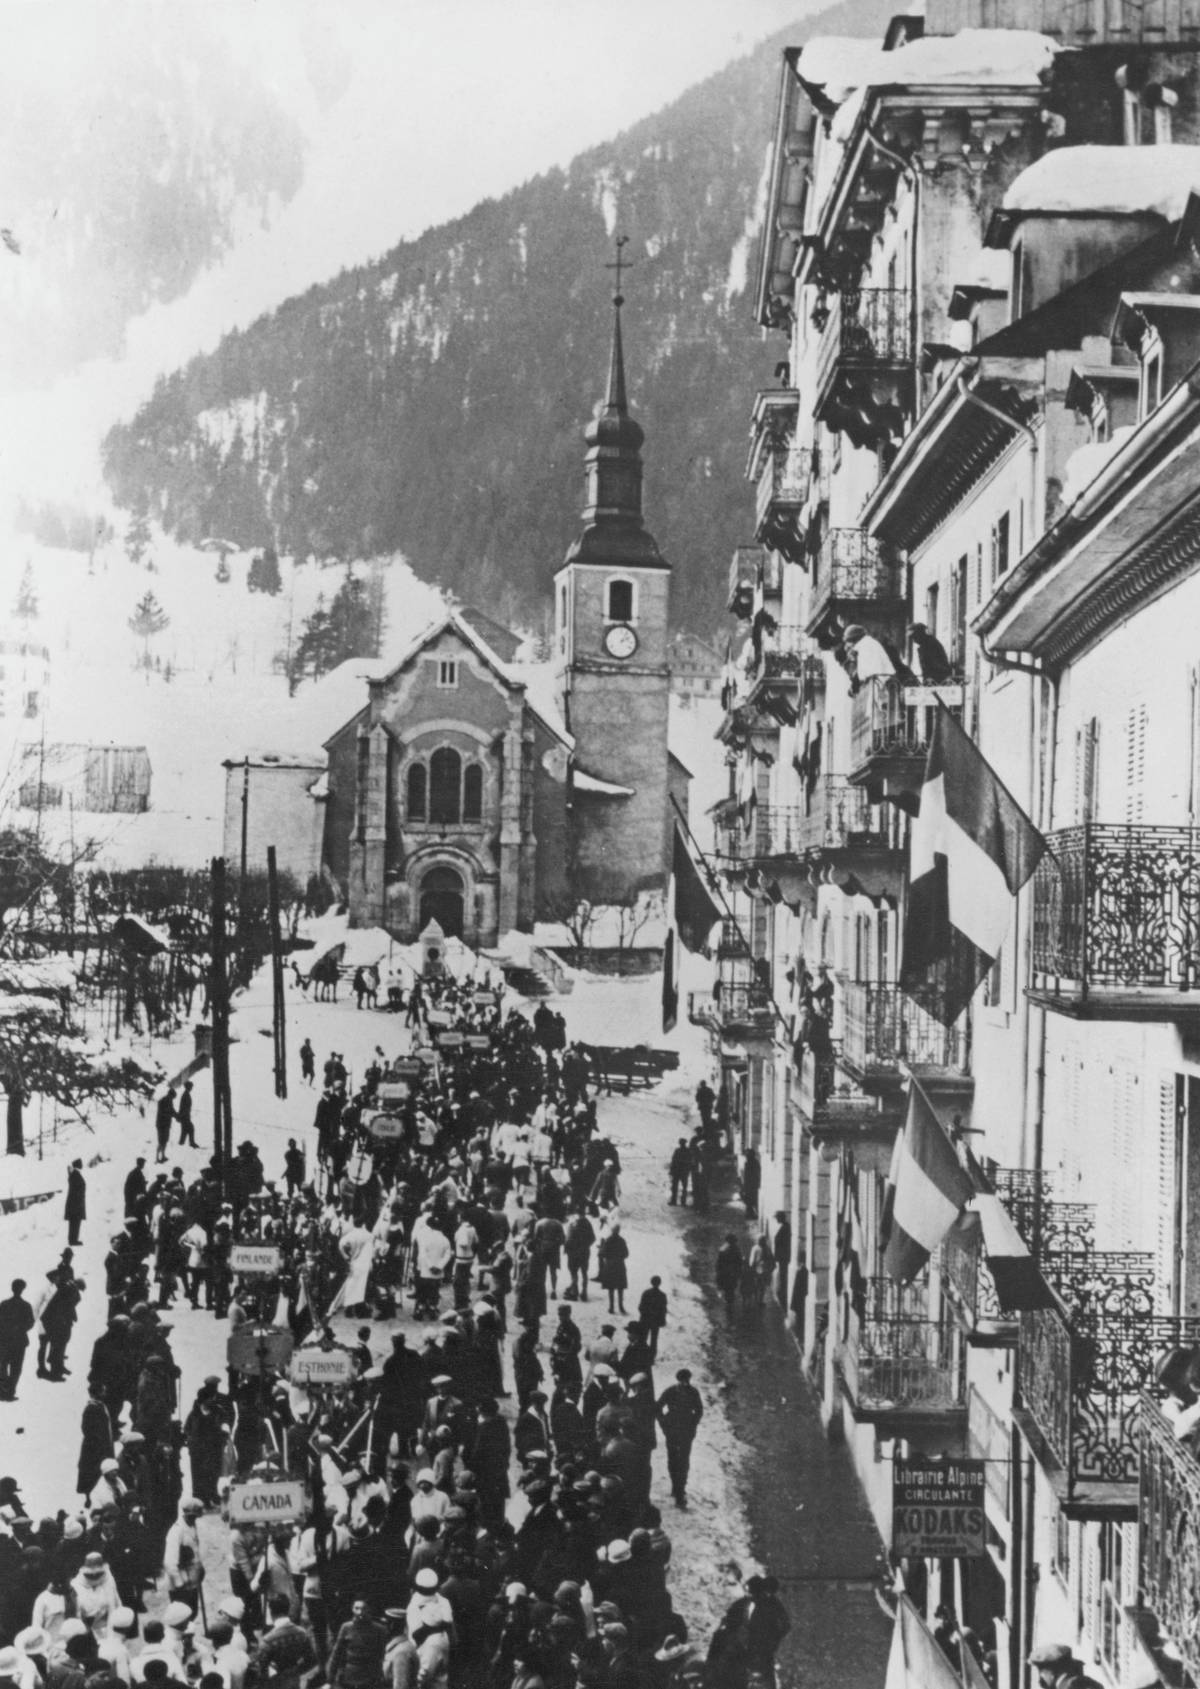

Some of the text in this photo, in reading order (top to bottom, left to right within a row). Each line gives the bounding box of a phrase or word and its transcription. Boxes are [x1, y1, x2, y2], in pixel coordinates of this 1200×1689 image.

[894, 1465, 983, 1487] Librairie Alpine
[242, 1493, 293, 1511] CANADA
[905, 1489, 974, 1501] CIRCULANTE
[895, 1508, 983, 1536] KODAKS
